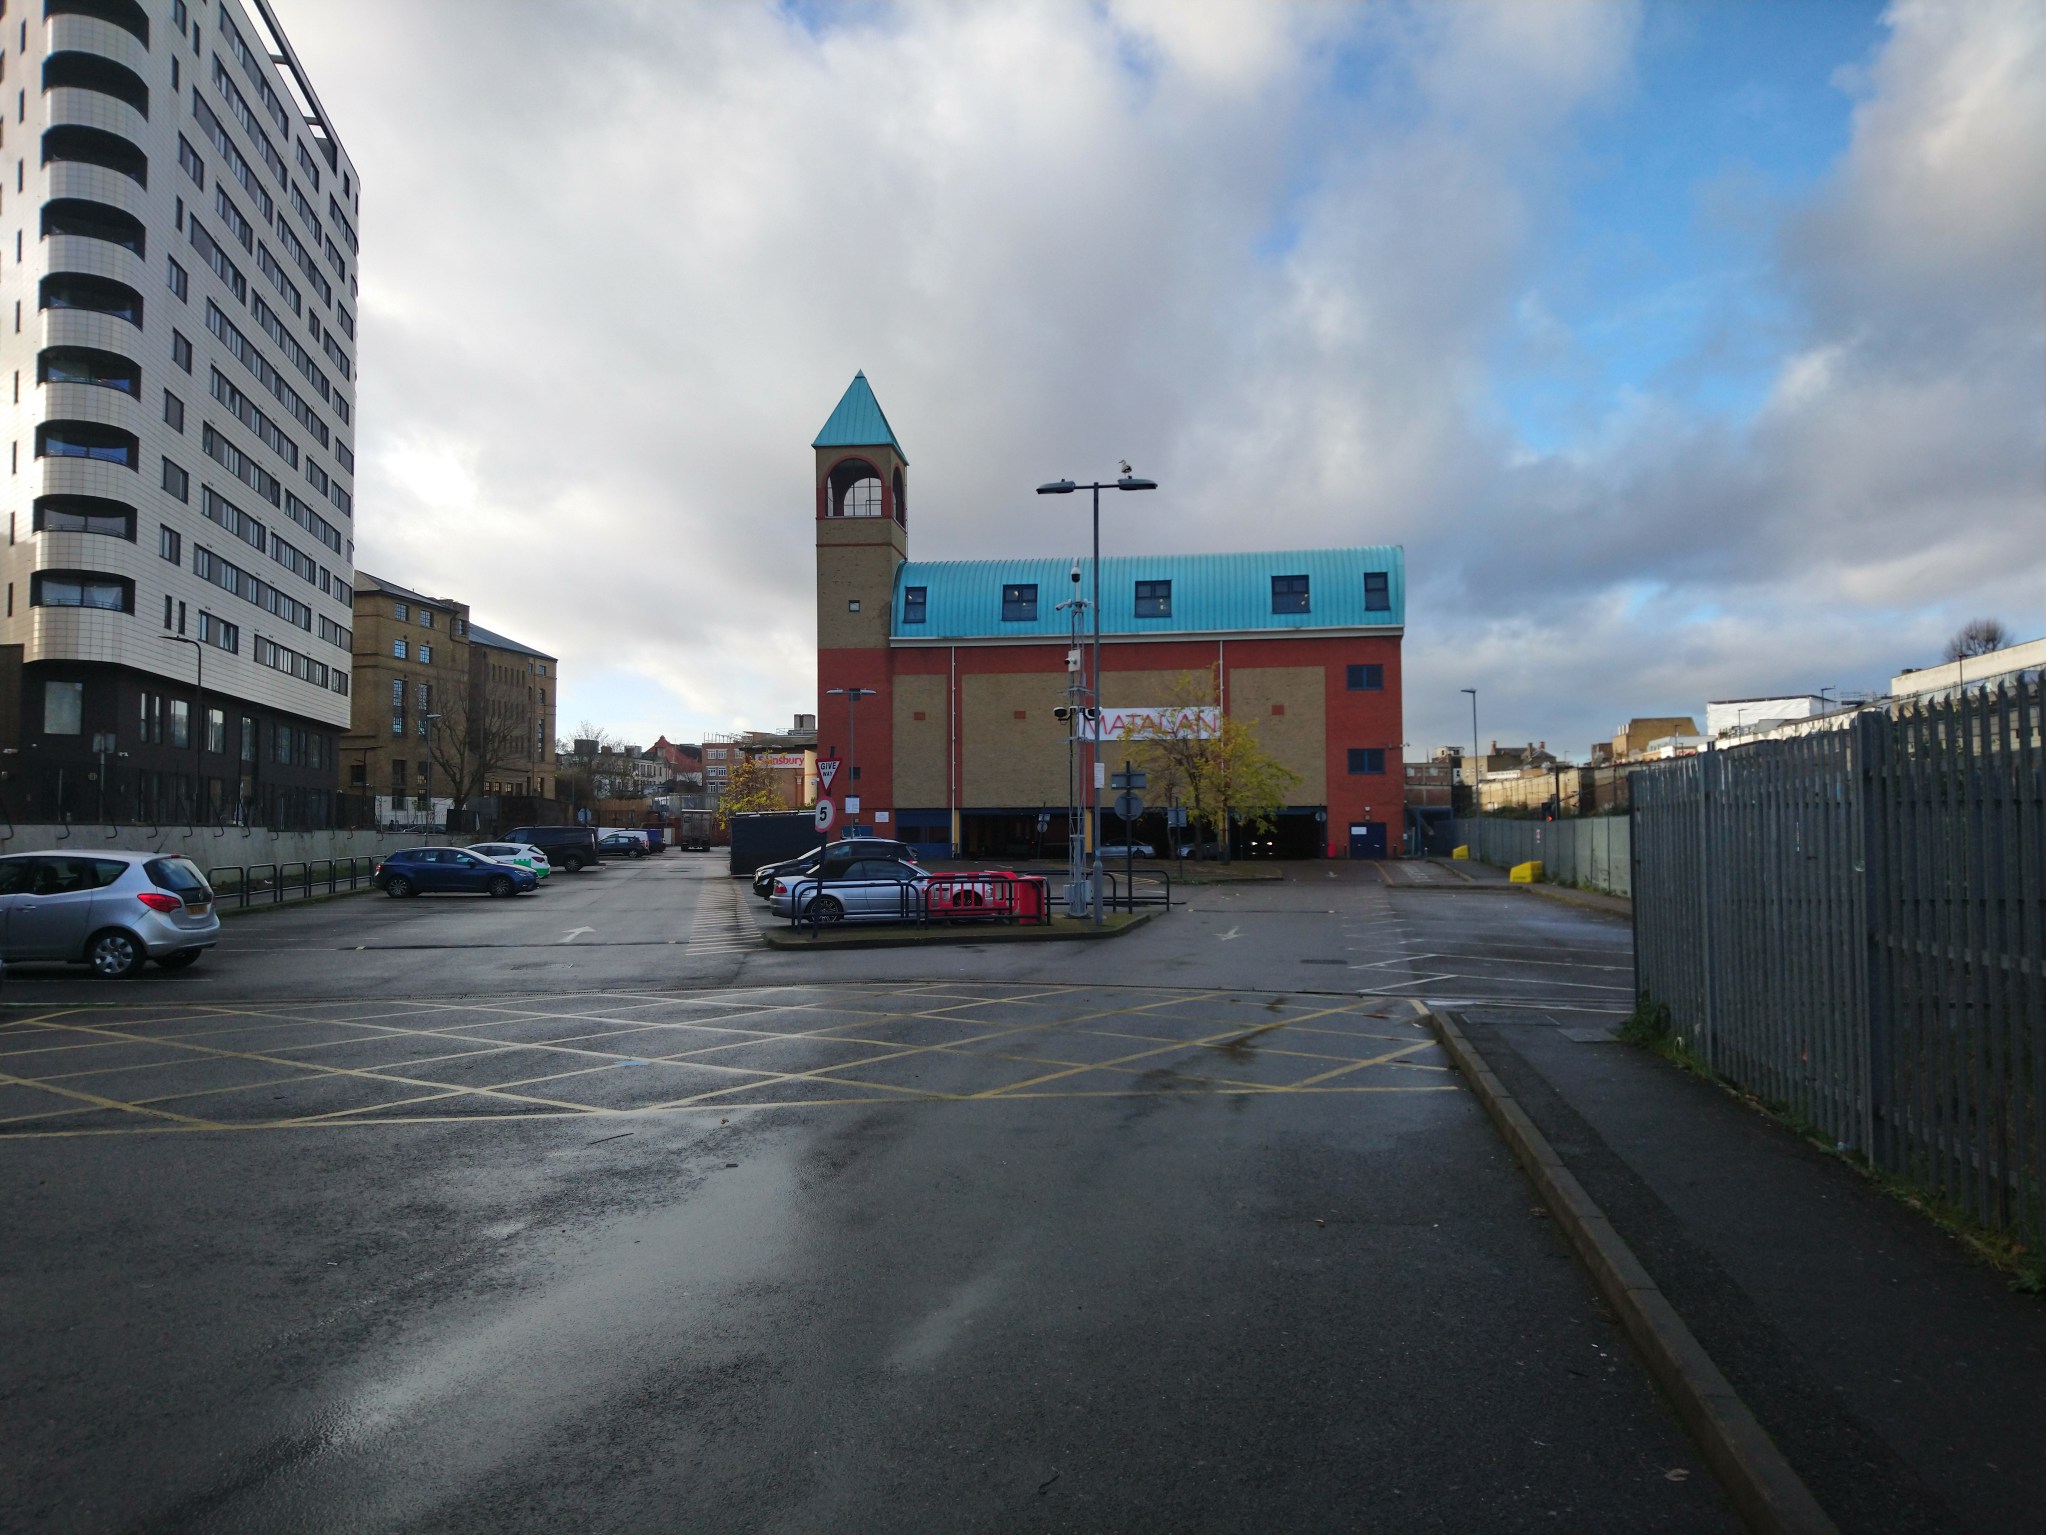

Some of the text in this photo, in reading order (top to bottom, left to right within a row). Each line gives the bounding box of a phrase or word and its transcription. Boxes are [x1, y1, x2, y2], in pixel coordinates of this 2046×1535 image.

[1081, 713, 1217, 735] MATALAN
[820, 762, 836, 770] GIVE
[819, 807, 828, 821] 5
